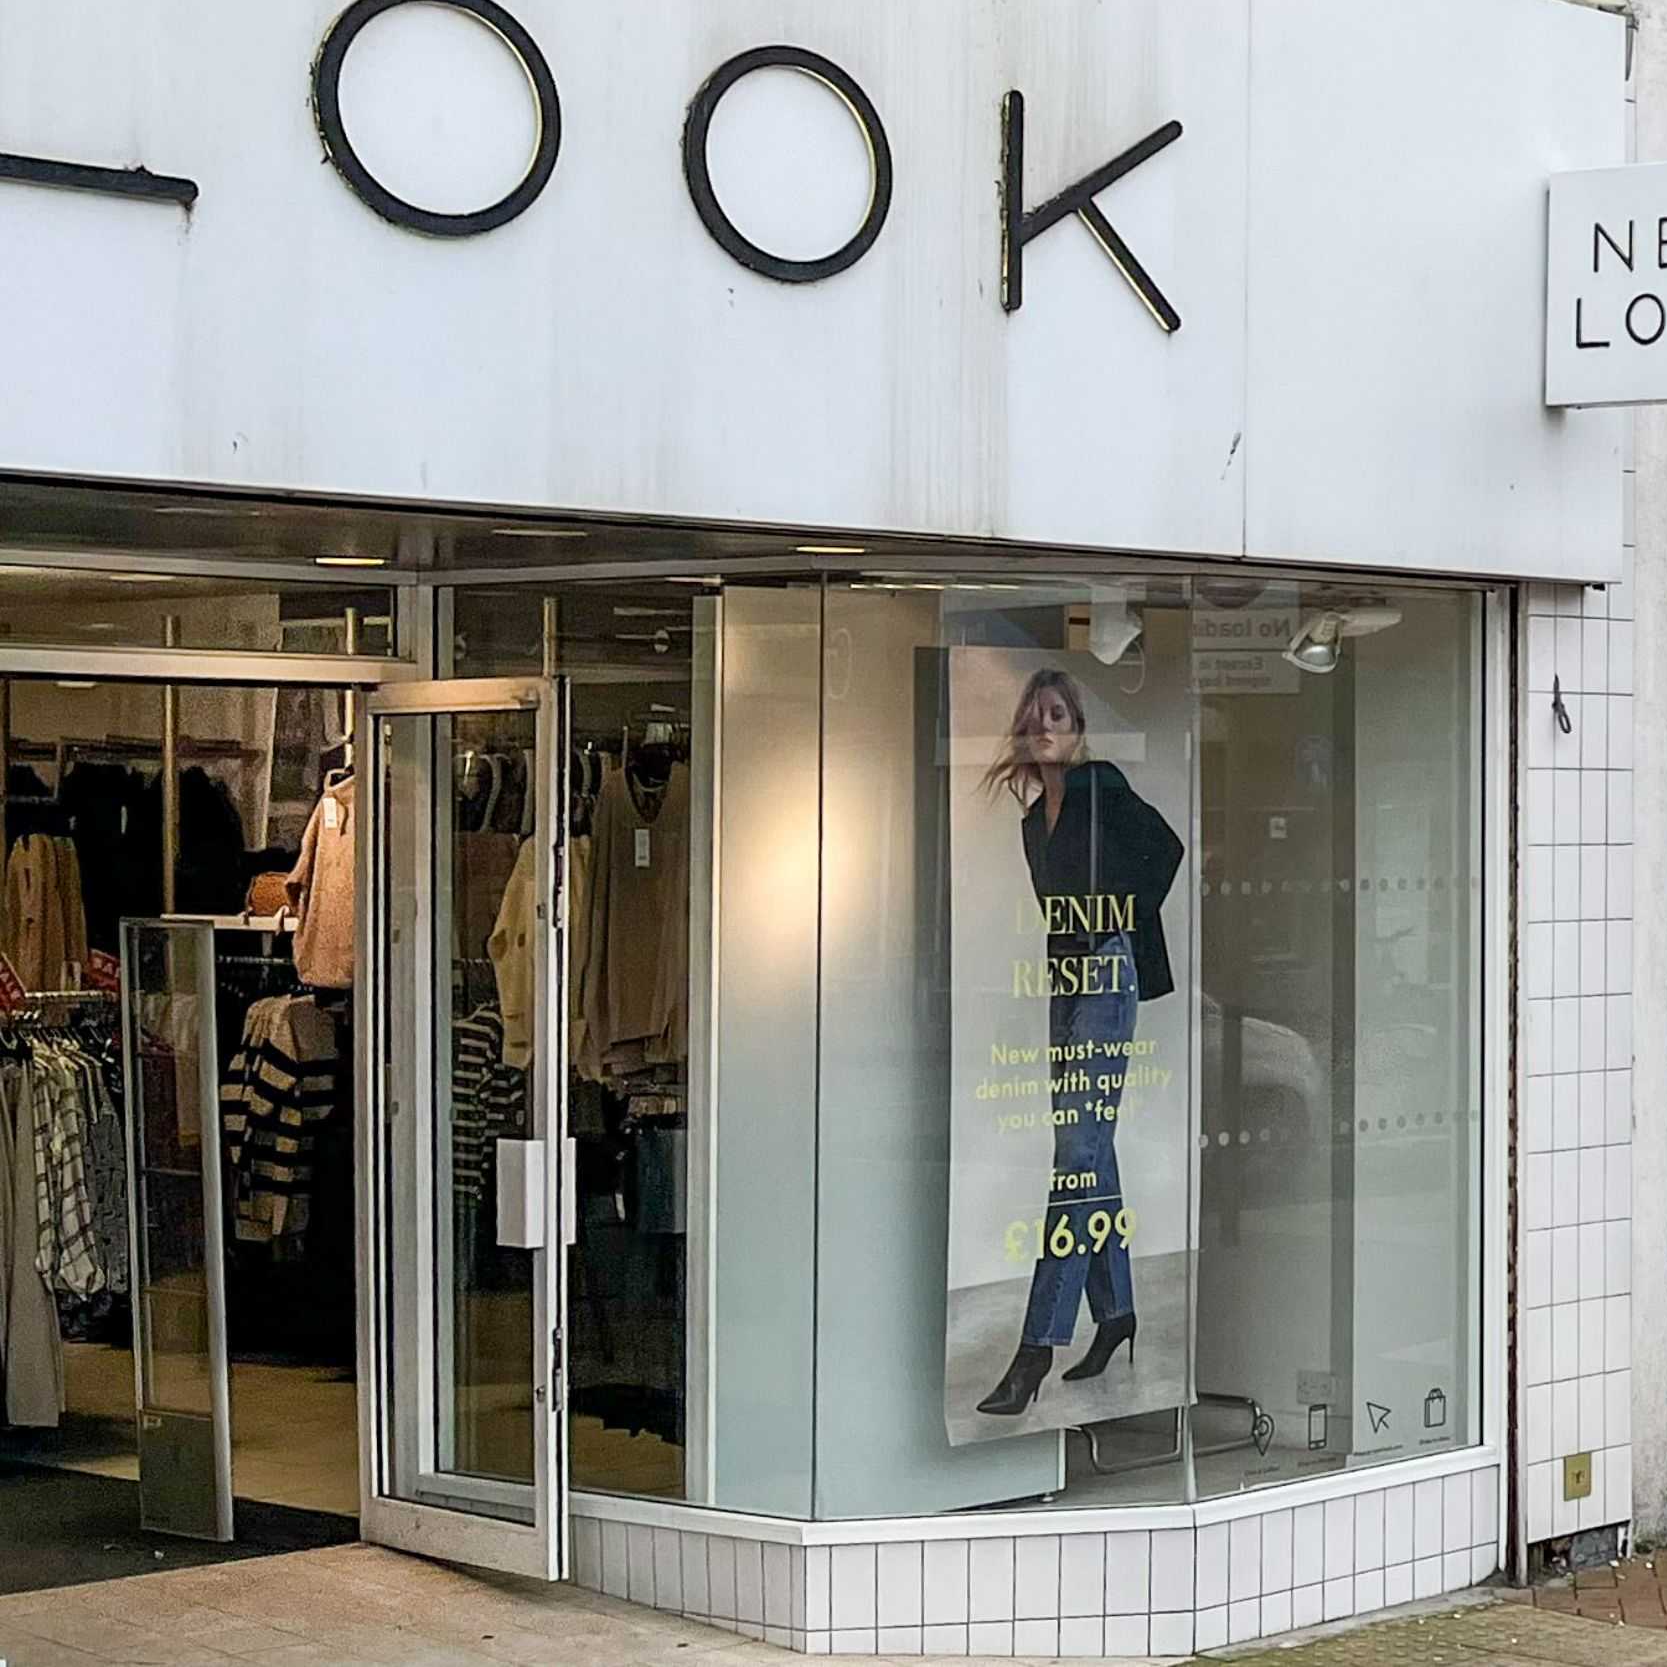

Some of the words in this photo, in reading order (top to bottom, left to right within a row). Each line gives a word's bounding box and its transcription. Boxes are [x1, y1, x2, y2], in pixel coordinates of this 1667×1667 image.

[1016, 893, 1136, 935] DENIM
[1011, 954, 1136, 999] RESET.
[991, 1042, 1039, 1066] New
[1046, 1038, 1157, 1063] must-wear
[975, 1077, 1039, 1100] denim
[1048, 1069, 1090, 1094] with
[1096, 1066, 1173, 1099] quality
[998, 1109, 1036, 1134] you
[1042, 1105, 1079, 1127] can
[1050, 1167, 1097, 1192] from
[1005, 1207, 1138, 1264] £16.99
